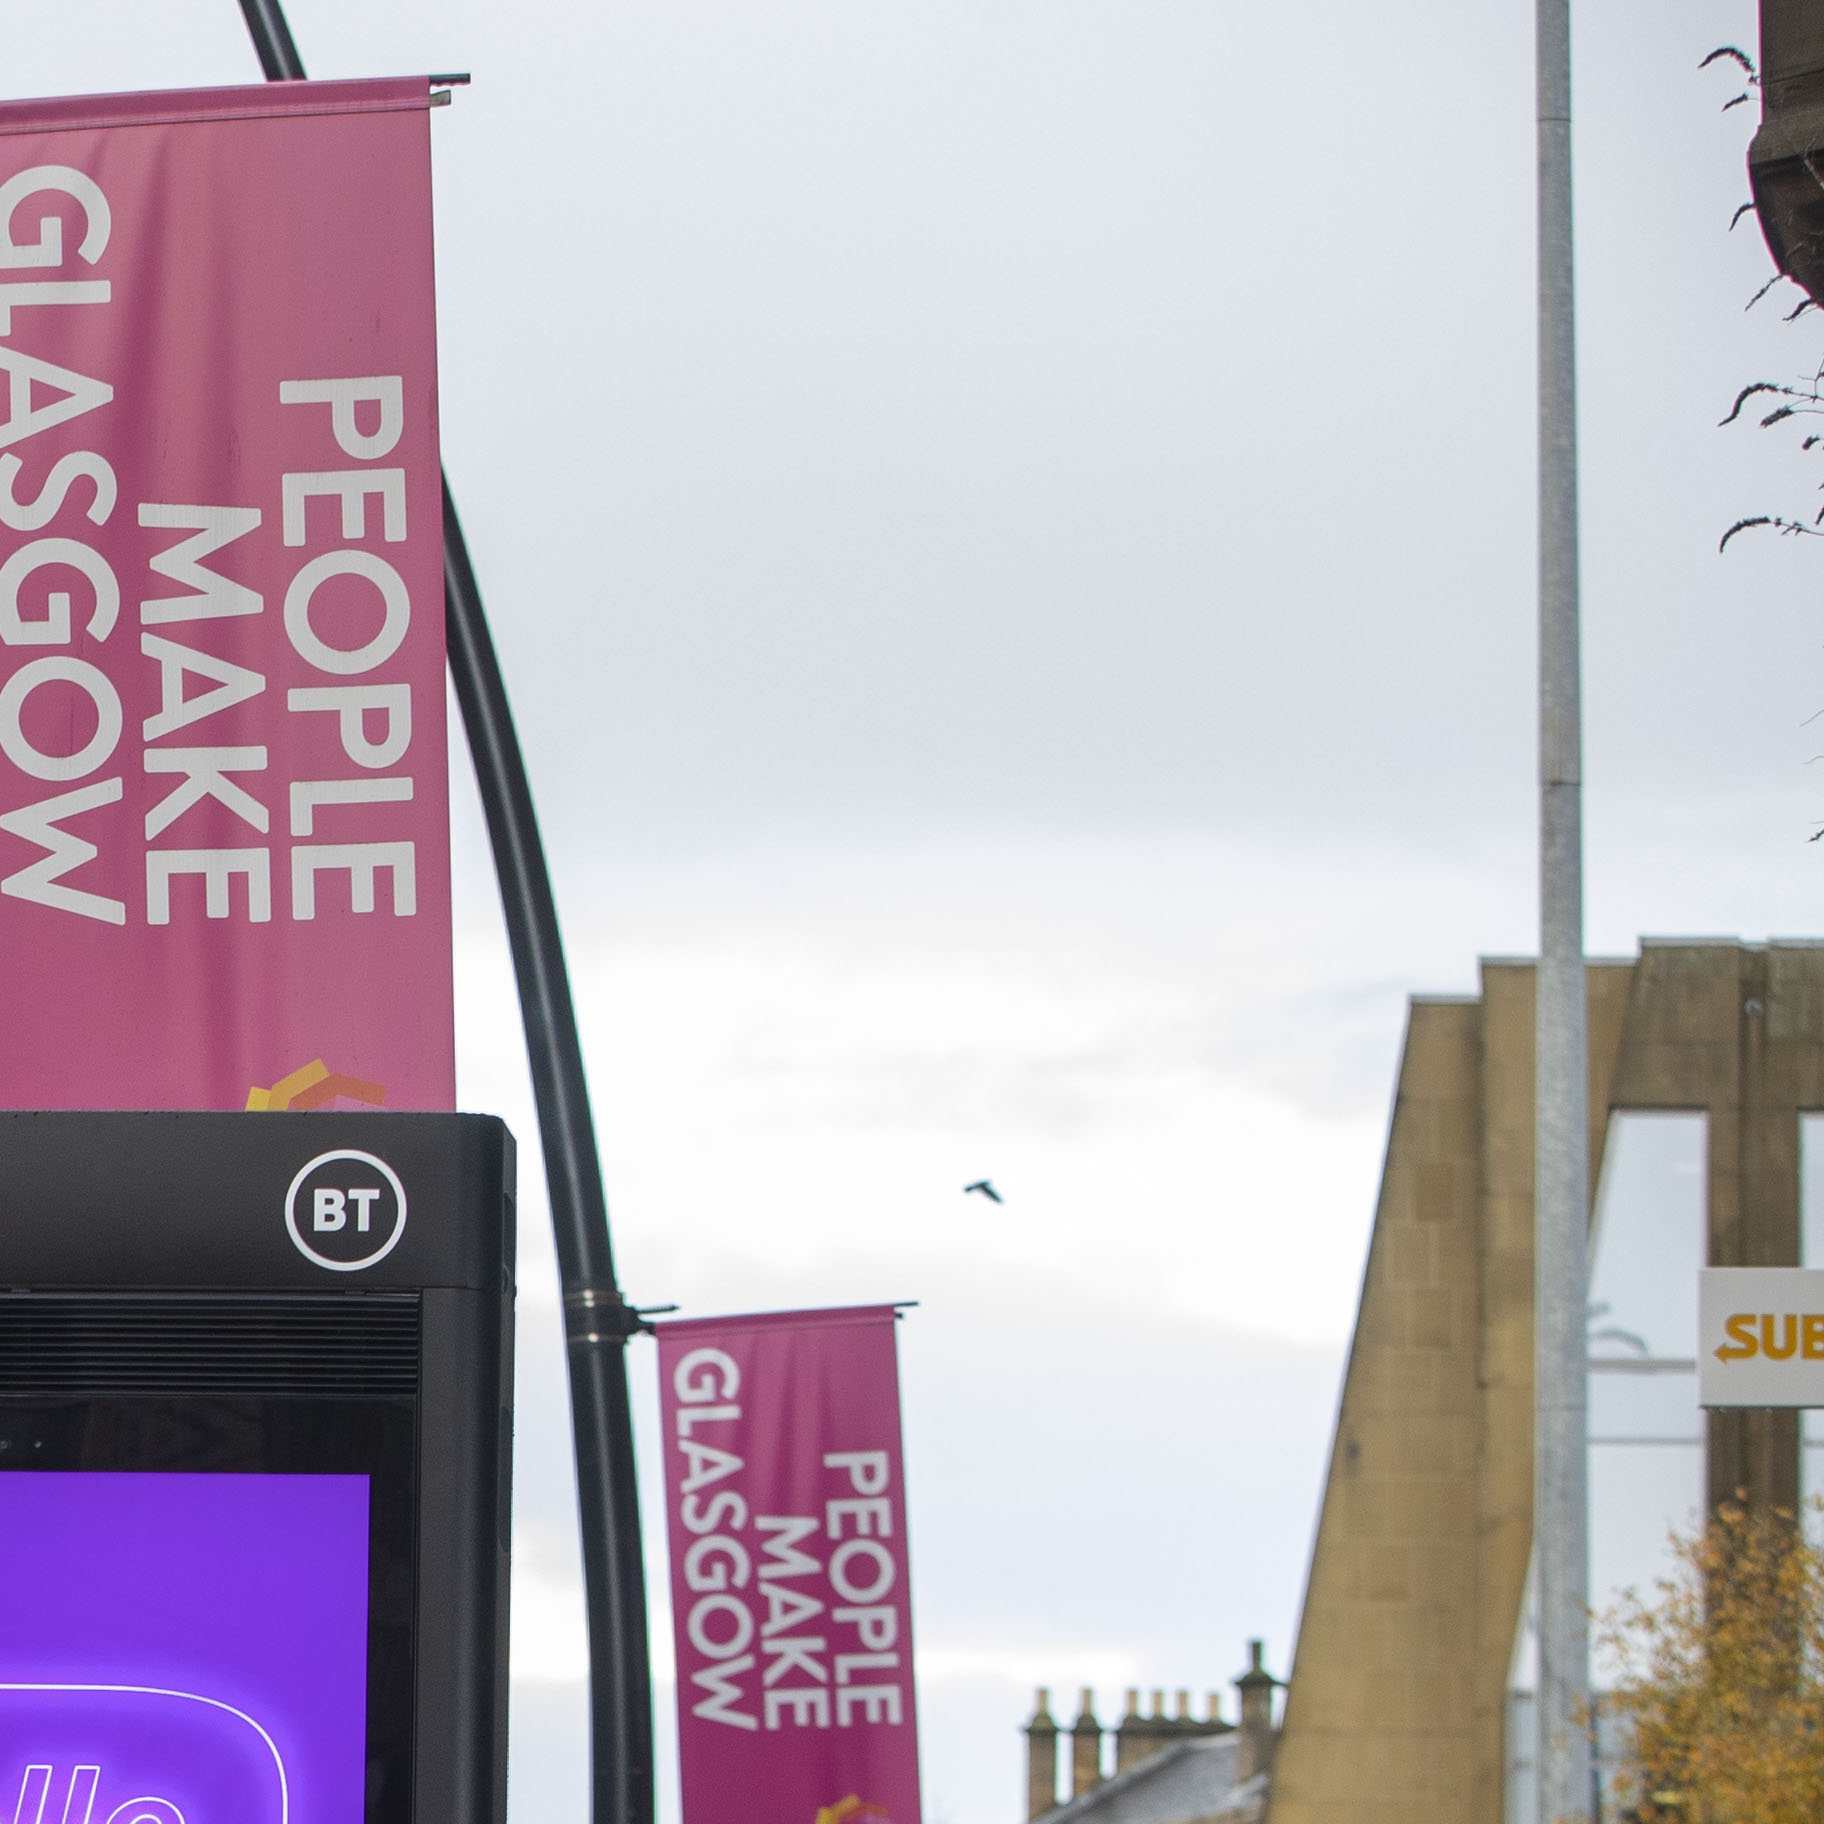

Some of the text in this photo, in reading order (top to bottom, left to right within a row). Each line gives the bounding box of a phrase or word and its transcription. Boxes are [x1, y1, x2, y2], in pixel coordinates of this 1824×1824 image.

[138, 502, 270, 925] MAKE
[280, 375, 417, 920] PEOPLE
[314, 1189, 380, 1231] BT
[673, 1349, 757, 1730] GLASGOW
[755, 1516, 830, 1730] MAKE
[824, 1451, 902, 1726] PEOPLE
